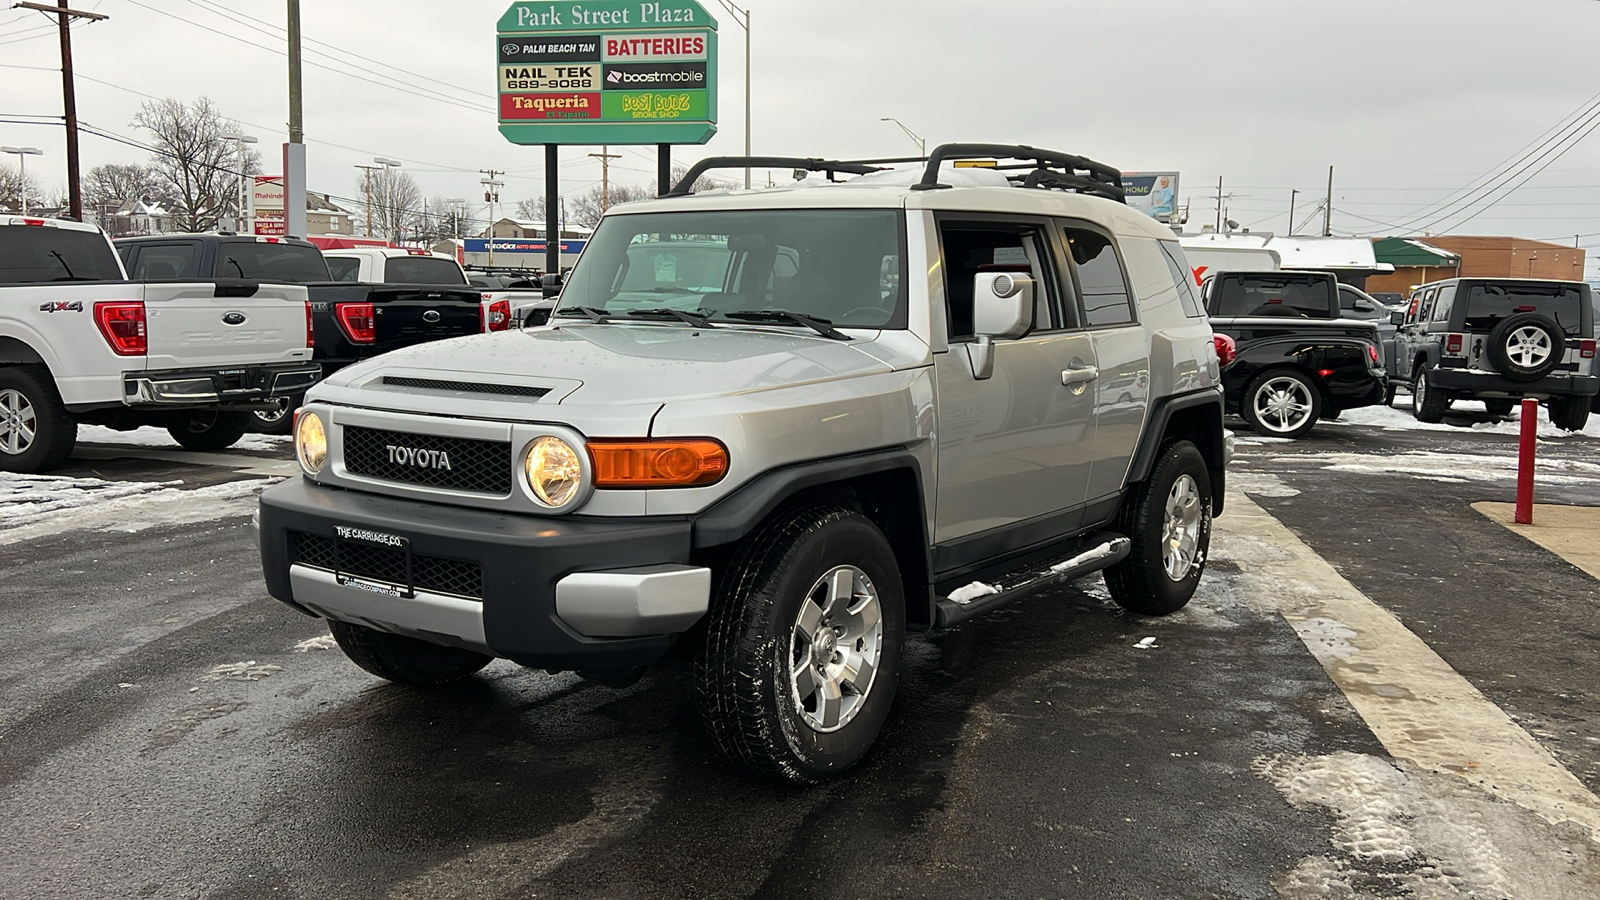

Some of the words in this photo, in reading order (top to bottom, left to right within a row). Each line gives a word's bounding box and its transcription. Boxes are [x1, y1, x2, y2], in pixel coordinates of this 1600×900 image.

[517, 6, 562, 26] Park
[571, 5, 629, 25] Street
[640, 2, 694, 23] Plaza
[523, 44, 546, 53] PALM
[547, 43, 577, 53] BEACH
[578, 43, 595, 52] TAN
[607, 37, 704, 56] BATTERIES
[505, 68, 547, 79] NAIL
[554, 66, 592, 78] TEK
[508, 79, 592, 89] 689-9088
[1125, 186, 1149, 194] HOME
[386, 445, 451, 470] TOYOTA
[336, 526, 352, 538] THE
[351, 529, 389, 545] CARRIAGE
